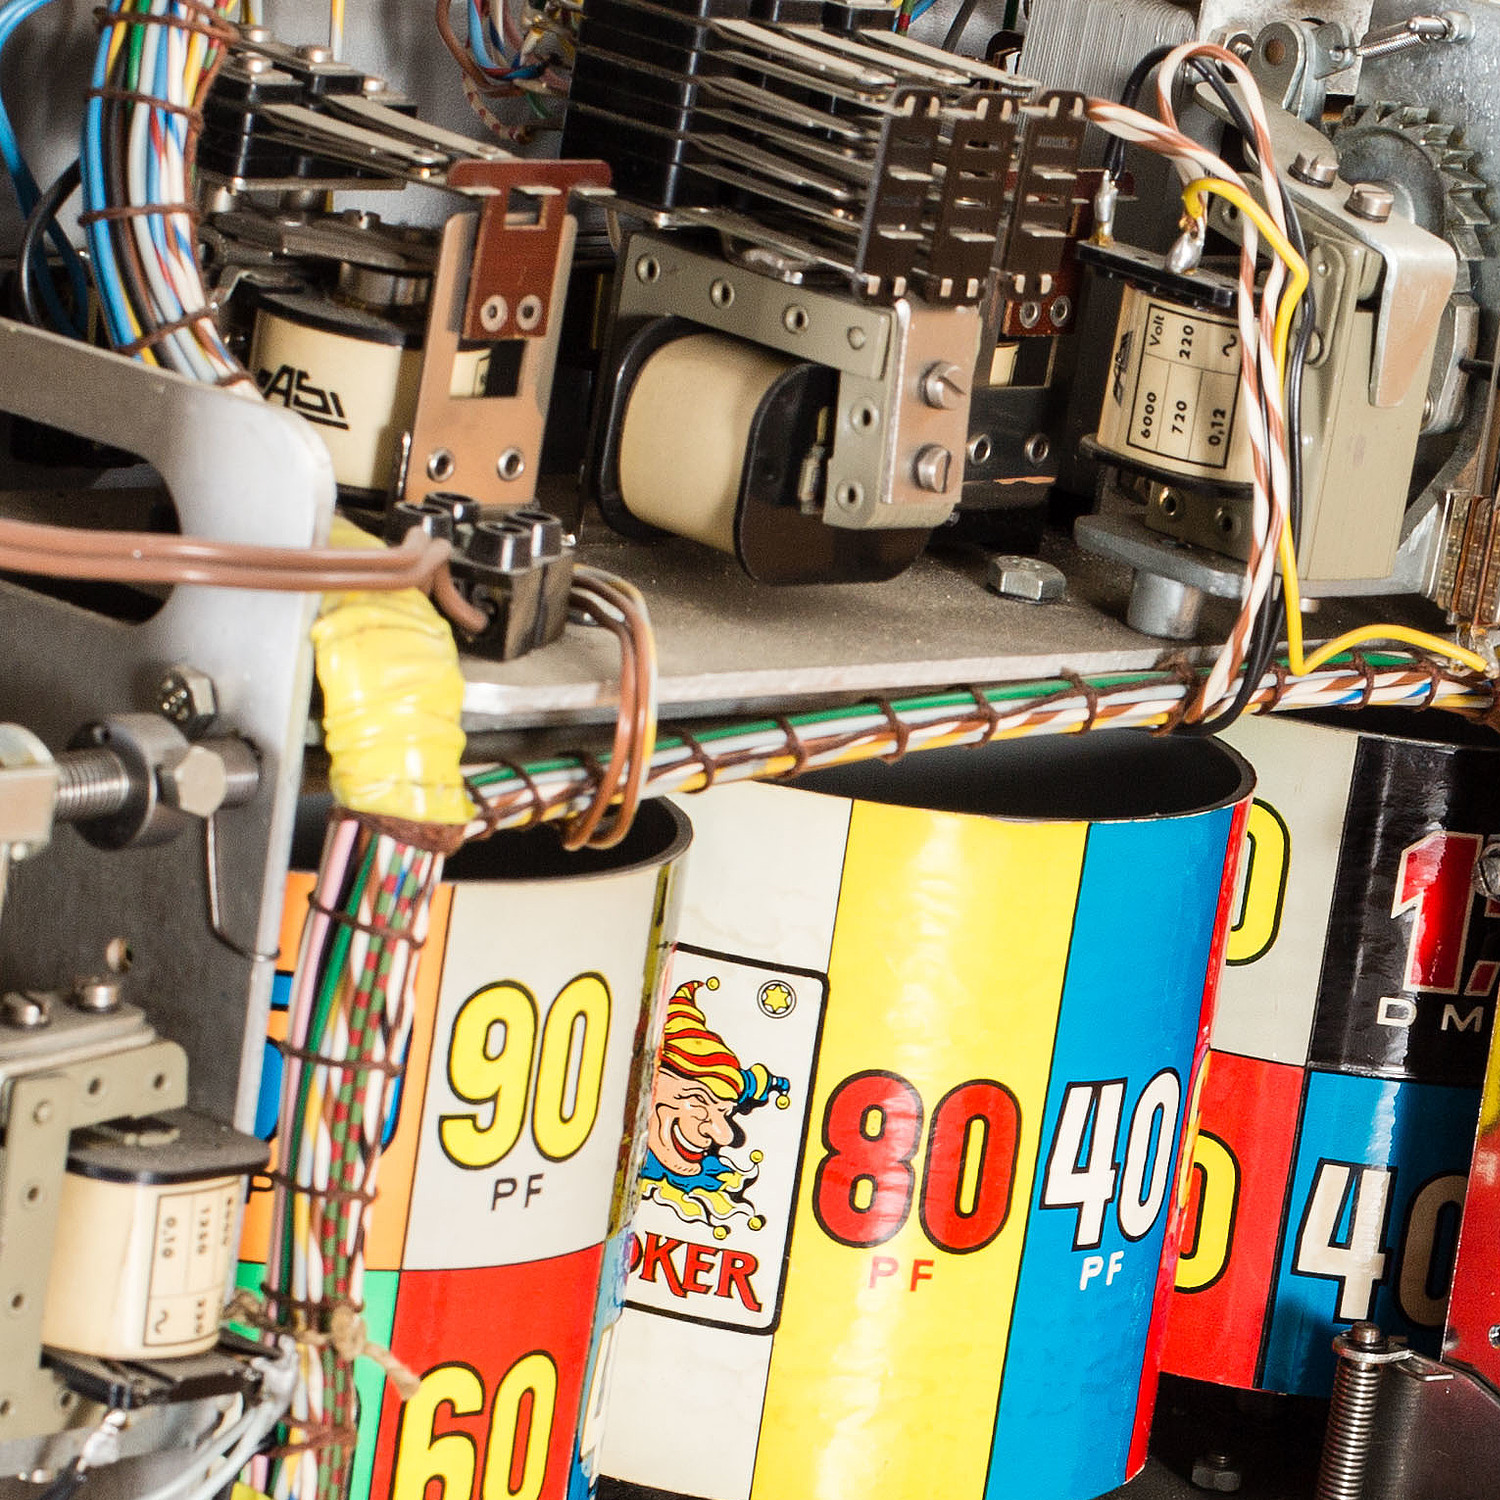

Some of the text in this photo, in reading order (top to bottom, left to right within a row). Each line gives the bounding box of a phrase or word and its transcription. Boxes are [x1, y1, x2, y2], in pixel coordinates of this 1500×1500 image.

[1149, 315, 1165, 347] Volt
[1179, 325, 1195, 360] 220
[256, 364, 346, 419] ASI
[1140, 391, 1158, 439] 6000
[1171, 400, 1188, 435] 720
[1207, 407, 1227, 447] 0,12
[438, 971, 612, 1171] 90
[812, 1069, 1023, 1255] 80
[1039, 1067, 1181, 1252] 40
[490, 1172, 544, 1212] PF
[1291, 1157, 1468, 1329] 40
[868, 1256, 935, 1293] PF
[1079, 1250, 1125, 1292] PF
